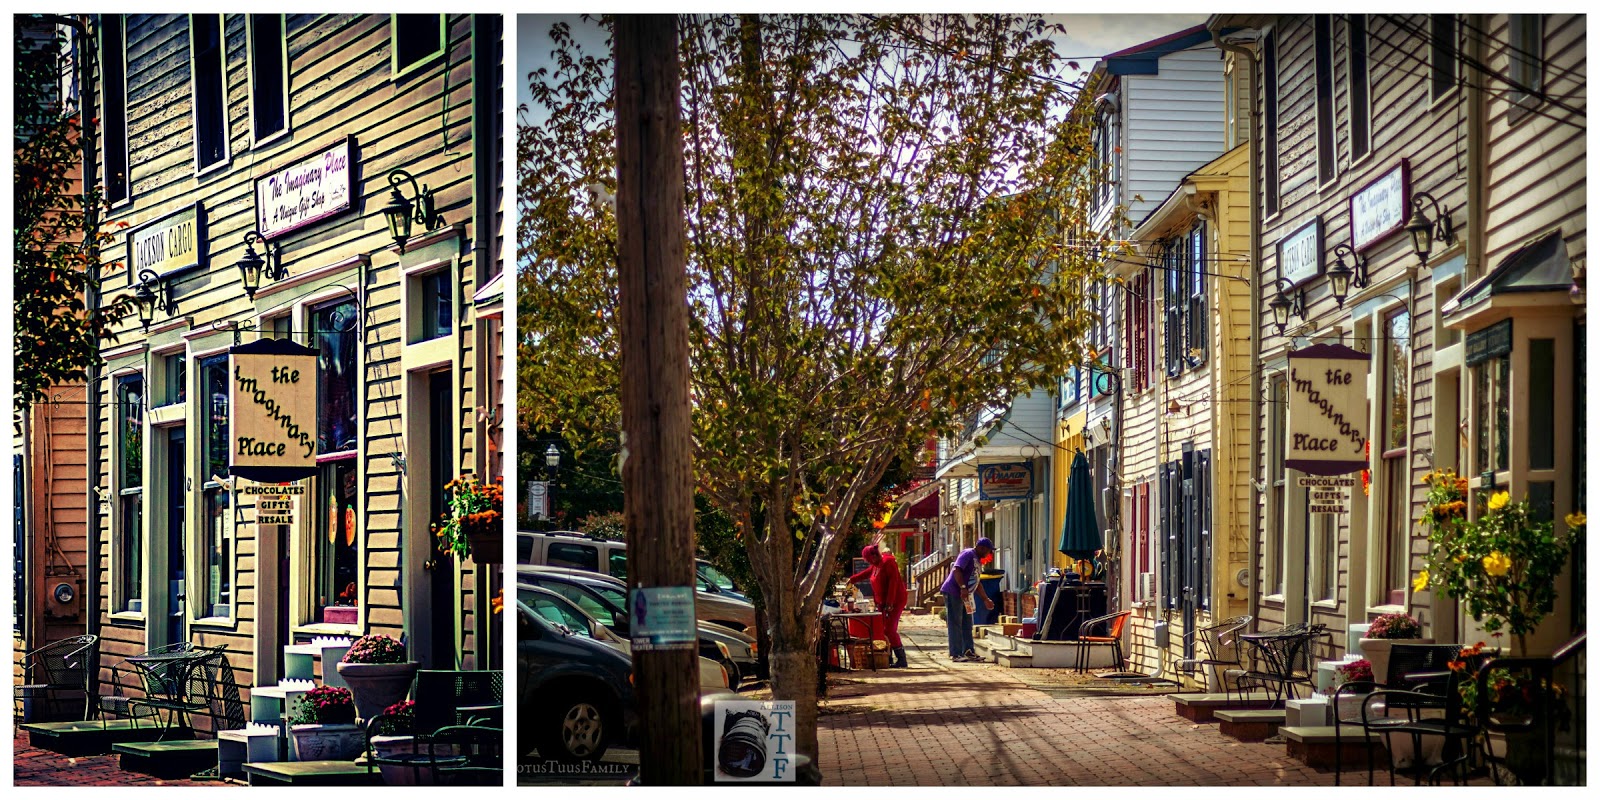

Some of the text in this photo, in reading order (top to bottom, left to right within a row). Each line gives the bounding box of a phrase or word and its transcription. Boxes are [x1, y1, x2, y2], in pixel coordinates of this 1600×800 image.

[268, 175, 282, 201] The
[285, 168, 322, 197] Imaginary
[325, 151, 346, 178] Place
[272, 207, 279, 225] A
[279, 204, 298, 223] Unique
[298, 196, 310, 219] Gift
[311, 189, 325, 209] Shop
[136, 222, 193, 271] JACKSON CARGO
[270, 365, 300, 384] the
[1325, 368, 1352, 385] the
[234, 365, 315, 459] imaginary
[1291, 367, 1366, 454] imaginary
[237, 436, 287, 457] Place
[1293, 432, 1338, 452] Place
[245, 486, 305, 495] CHOCOLATES
[1299, 478, 1355, 487] CHOCOLATES
[261, 501, 290, 509] GIFTS
[1314, 492, 1341, 500] GIFTS
[1311, 505, 1344, 513] RESALE
[258, 515, 293, 524] RESALE
